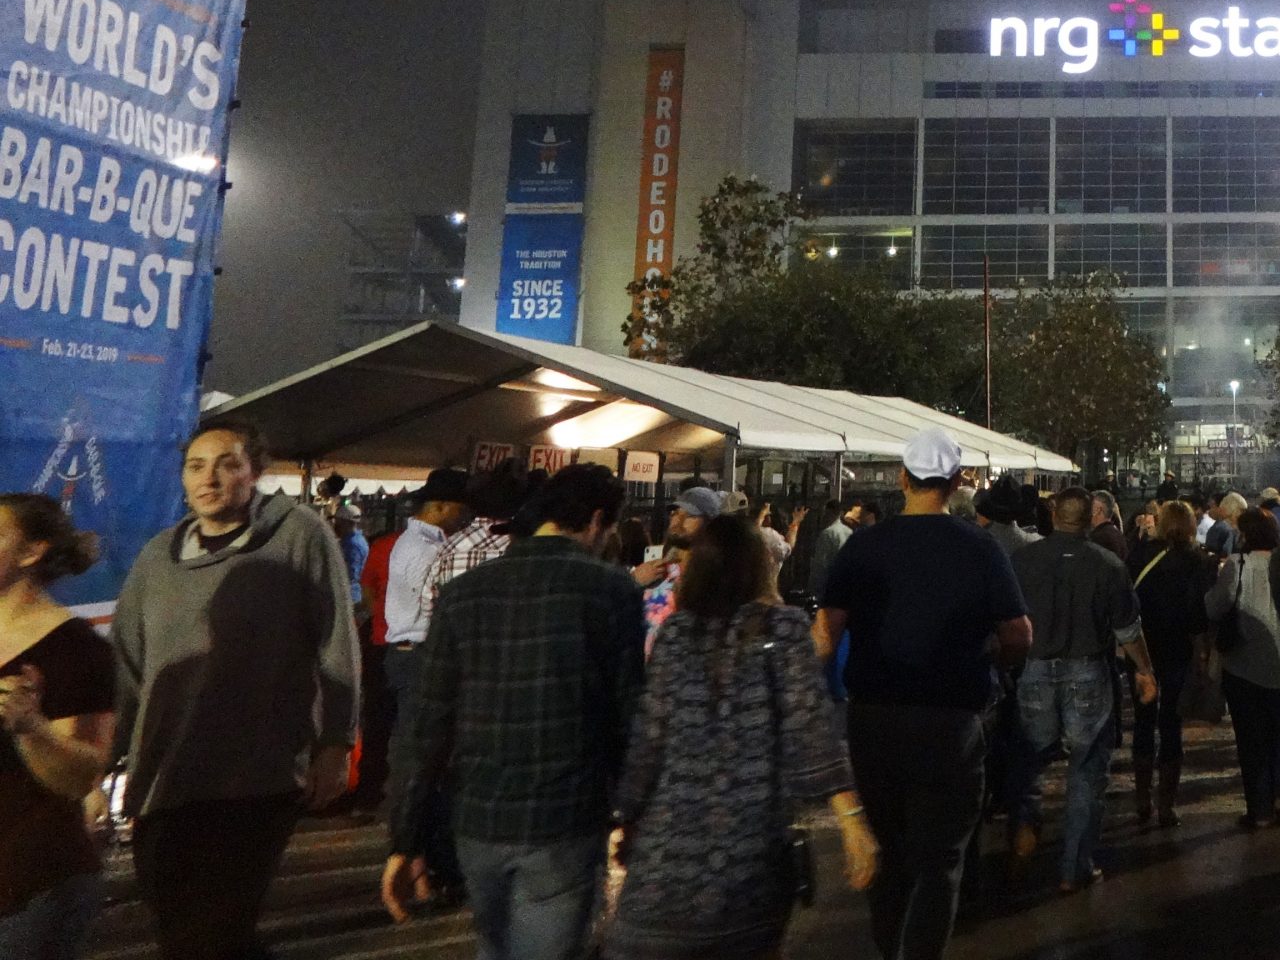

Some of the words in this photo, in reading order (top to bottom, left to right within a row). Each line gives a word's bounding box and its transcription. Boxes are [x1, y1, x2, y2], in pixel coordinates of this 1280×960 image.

[989, 16, 1098, 74] nrg
[0, 126, 203, 243] BAR-B-QUE
[513, 280, 563, 297] SINCE
[510, 298, 562, 319] 1932
[533, 448, 566, 474] EXIT
[632, 463, 641, 473] NO
[642, 463, 654, 474] EXIT
